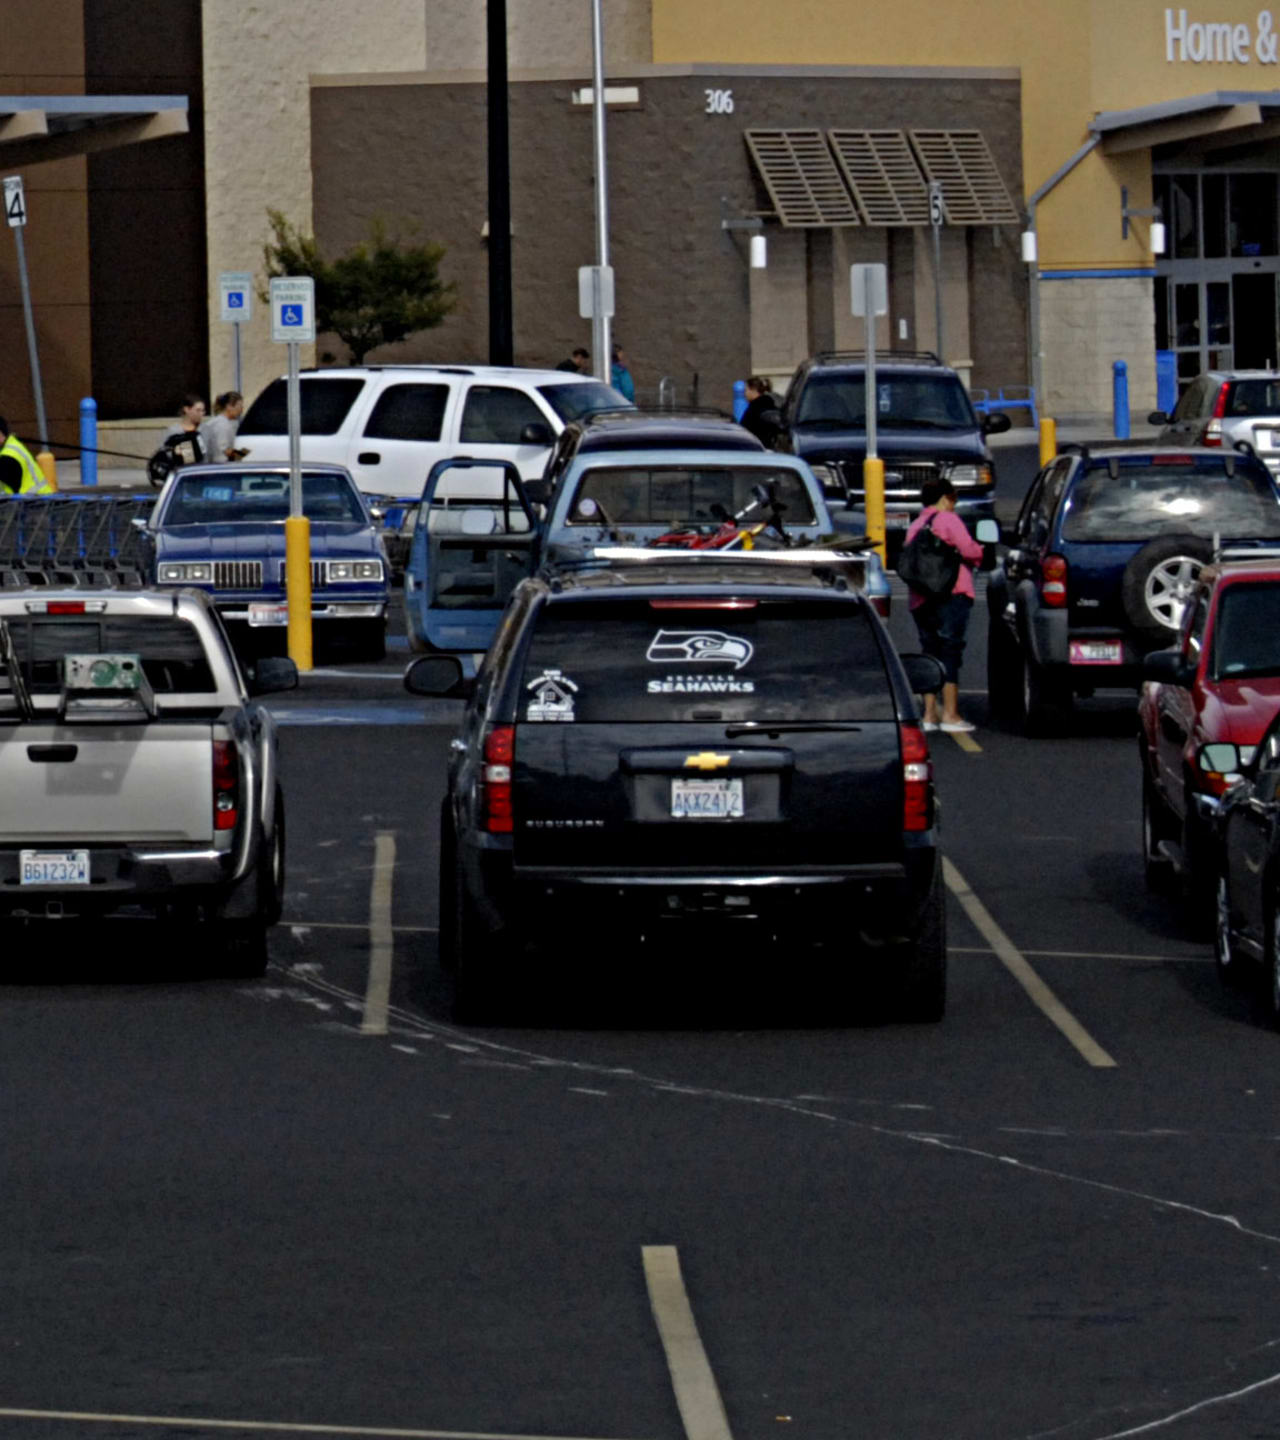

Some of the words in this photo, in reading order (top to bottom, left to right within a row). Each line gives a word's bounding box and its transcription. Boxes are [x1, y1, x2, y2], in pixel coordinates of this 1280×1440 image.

[1165, 8, 1250, 63] Home
[1256, 10, 1278, 63] &
[704, 89, 734, 113] 306
[8, 191, 24, 223] 4
[932, 195, 941, 223] 5
[647, 680, 755, 693] SEAHAWKS
